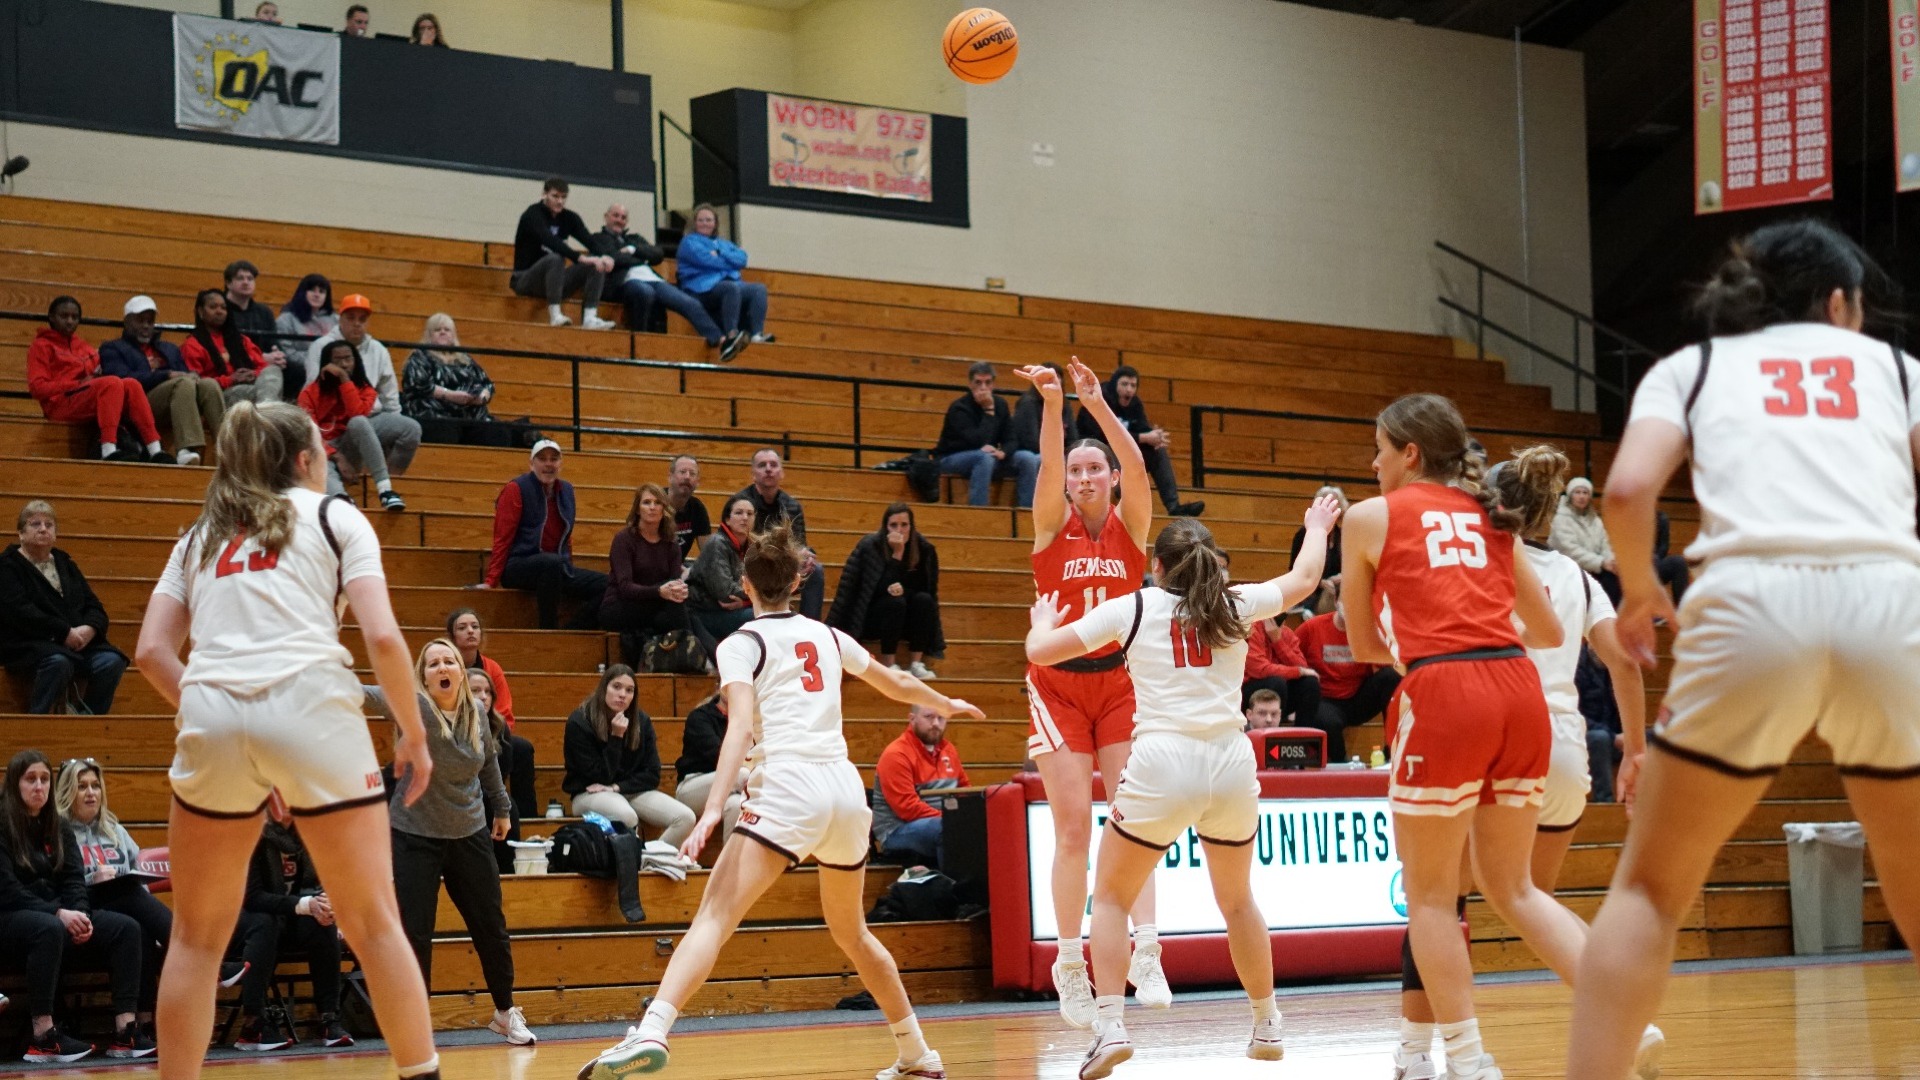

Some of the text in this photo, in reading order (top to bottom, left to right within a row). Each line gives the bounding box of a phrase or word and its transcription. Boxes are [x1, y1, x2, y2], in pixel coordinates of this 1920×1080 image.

[972, 27, 1015, 51] Wilson
[1897, 14, 1917, 83] GOLF
[220, 60, 324, 109] OAC
[1700, 22, 1719, 110] GOLF
[774, 101, 926, 142] WOBN 97.5
[773, 161, 869, 190] Otterbein
[1759, 356, 1859, 419] 33
[1420, 510, 1488, 569] 25
[794, 641, 824, 692] 3
[1280, 744, 1306, 759] POSS.
[1256, 812, 1391, 867] UNIVERS
